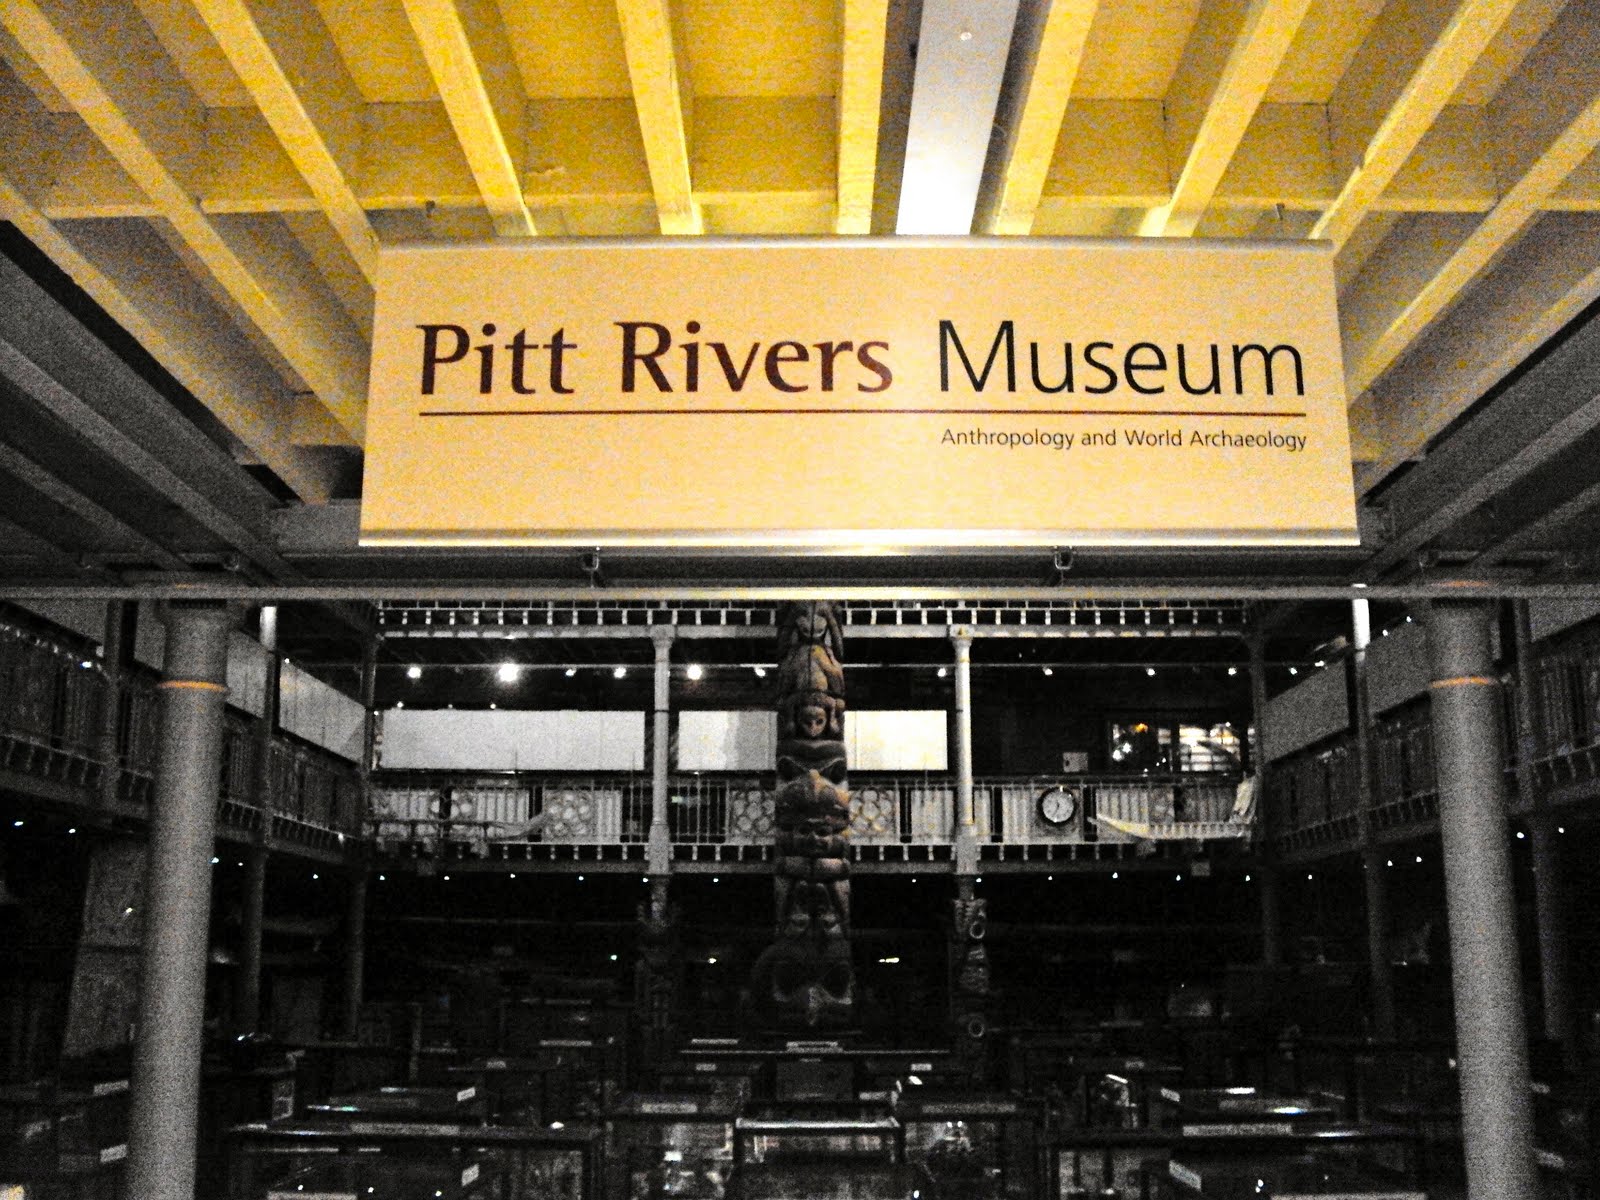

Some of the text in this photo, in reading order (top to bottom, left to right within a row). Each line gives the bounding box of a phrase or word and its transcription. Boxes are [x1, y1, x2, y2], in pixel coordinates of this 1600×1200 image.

[416, 319, 1305, 395] Pitt Rivers Museum
[941, 428, 1307, 452] Anthropology and World Archaeology
